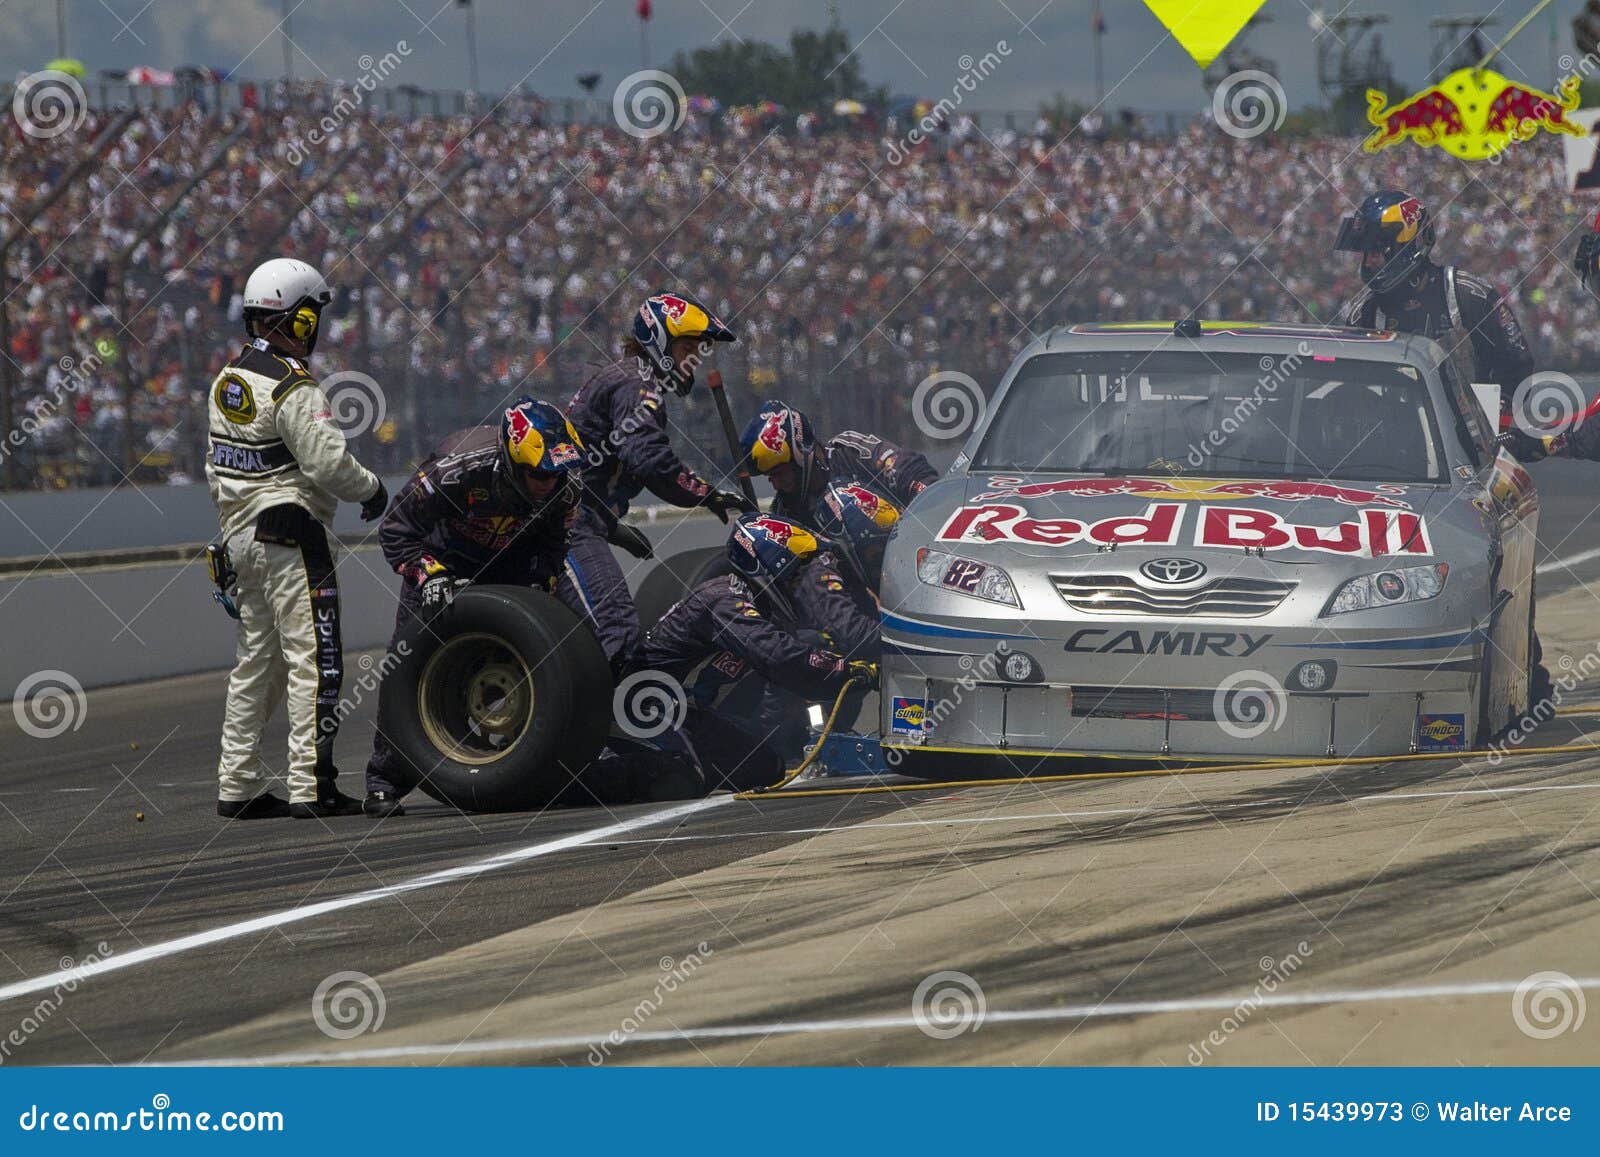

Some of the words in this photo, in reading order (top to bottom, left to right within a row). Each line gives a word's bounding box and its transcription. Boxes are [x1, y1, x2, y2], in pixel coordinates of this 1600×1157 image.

[934, 503, 1187, 547] Red
[1193, 505, 1434, 558] Bull
[943, 558, 986, 592] 82
[315, 608, 340, 678] Sprint
[1064, 629, 1275, 657] CAMRY
[1421, 725, 1462, 736] SUNOCO
